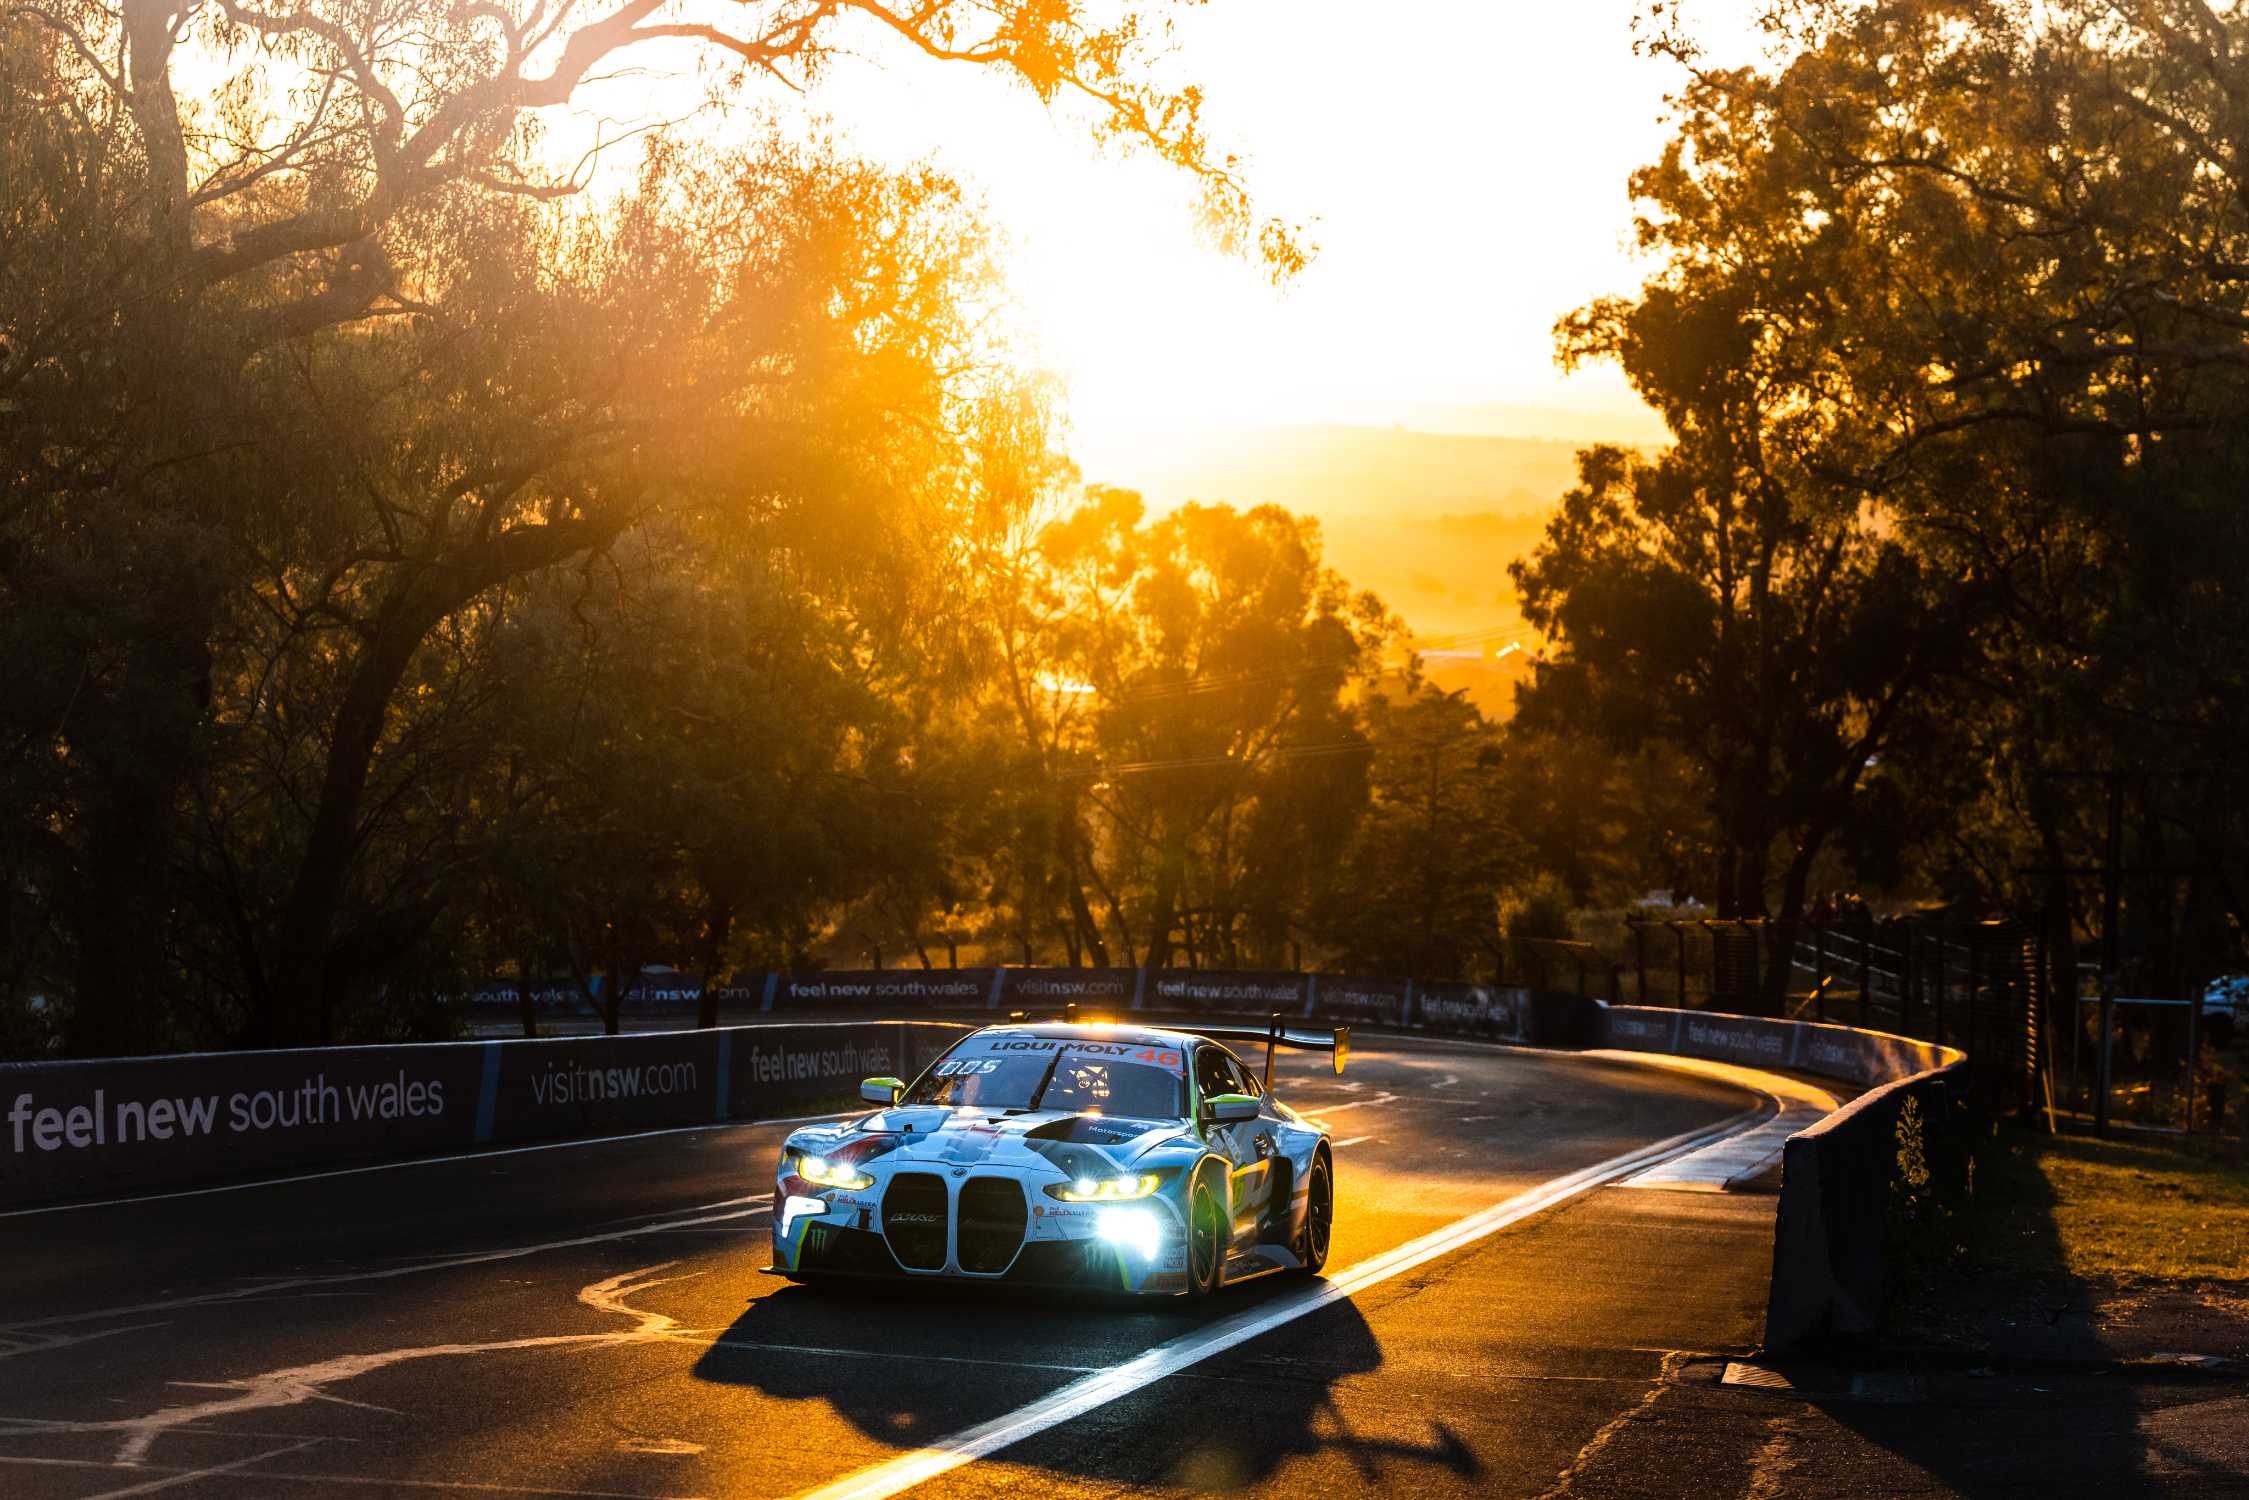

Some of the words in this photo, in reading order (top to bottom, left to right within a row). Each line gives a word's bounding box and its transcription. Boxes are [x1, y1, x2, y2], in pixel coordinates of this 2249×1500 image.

[790, 981, 826, 997] feel
[829, 984, 871, 997] new
[875, 981, 926, 997] south
[928, 980, 978, 996] wales
[1016, 979, 1124, 995] visitnsw.com
[1157, 980, 1186, 997] feel
[1187, 983, 1220, 998] new
[1223, 982, 1262, 999] south
[1263, 983, 1299, 1001] wales
[990, 1041, 1057, 1052] LIQUI
[1062, 1043, 1132, 1056] MOLY
[1135, 1048, 1180, 1067] 46
[750, 1044, 786, 1083] feel
[787, 1050, 819, 1080] new
[822, 1040, 860, 1078] south
[860, 1039, 891, 1073] wales
[531, 1059, 697, 1105] visitnsw.com
[8, 1089, 105, 1154] feel
[117, 1095, 219, 1143] new
[229, 1073, 340, 1133] south
[346, 1069, 445, 1121] wales
[1088, 1126, 1139, 1139] Motorspor
